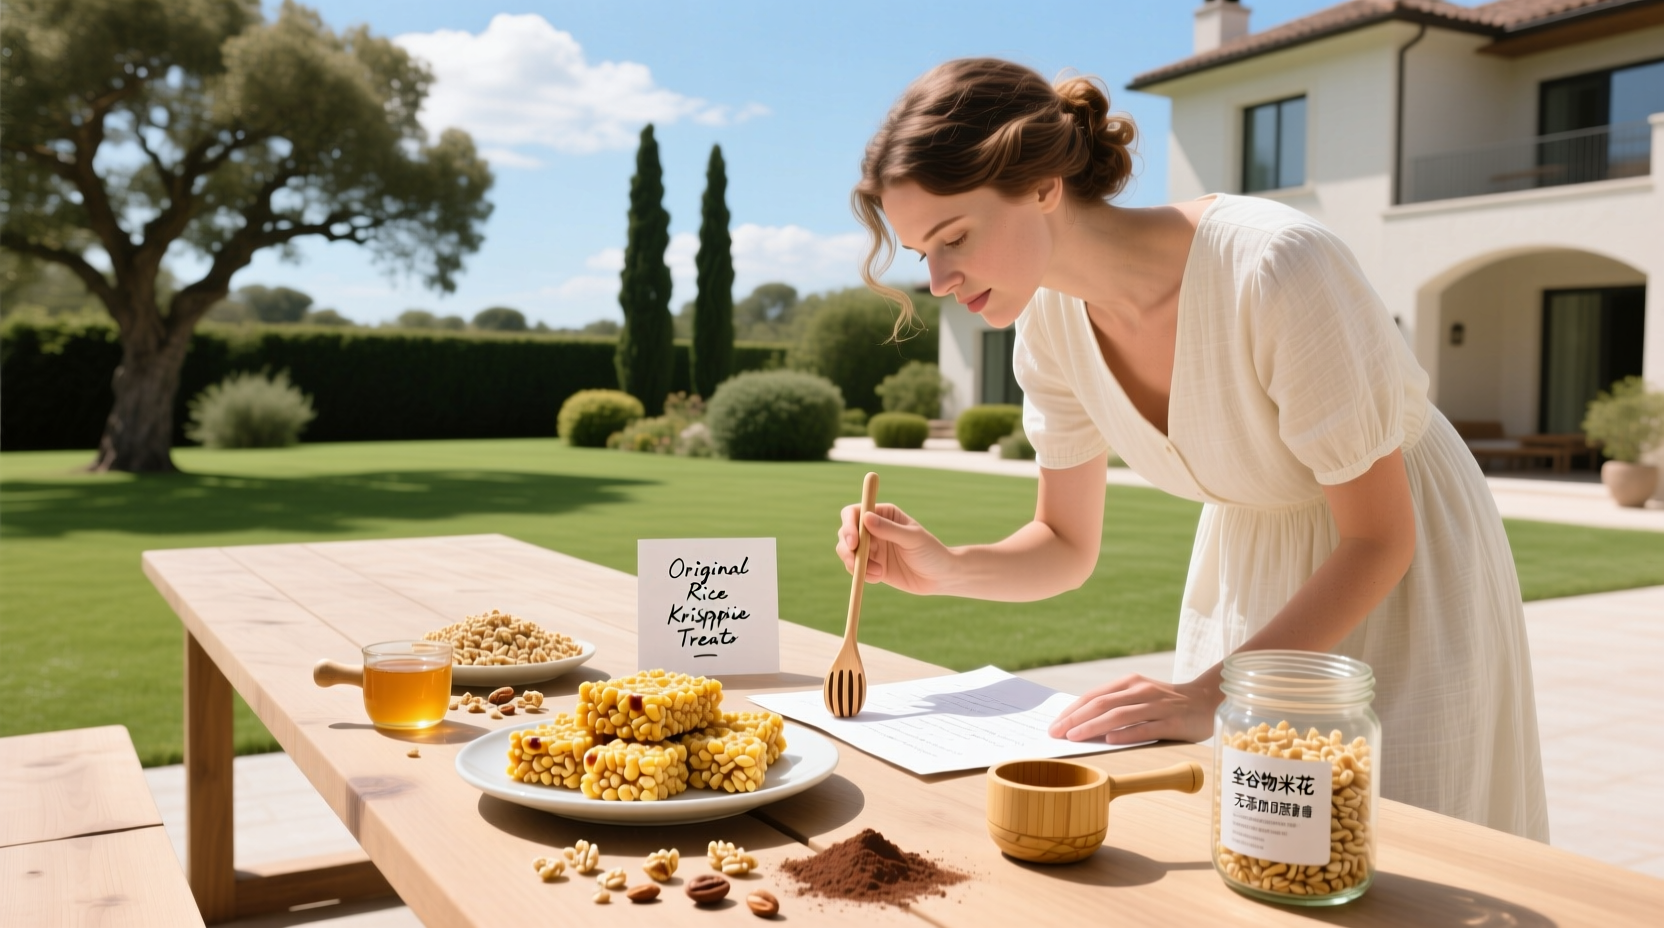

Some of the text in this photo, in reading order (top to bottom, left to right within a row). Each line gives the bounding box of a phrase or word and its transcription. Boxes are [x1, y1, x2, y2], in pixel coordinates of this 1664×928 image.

[669, 556, 749, 585] Original
[687, 582, 728, 601] Rice
[677, 628, 739, 647] Treats
[1232, 766, 1315, 796] 全谷物米花
